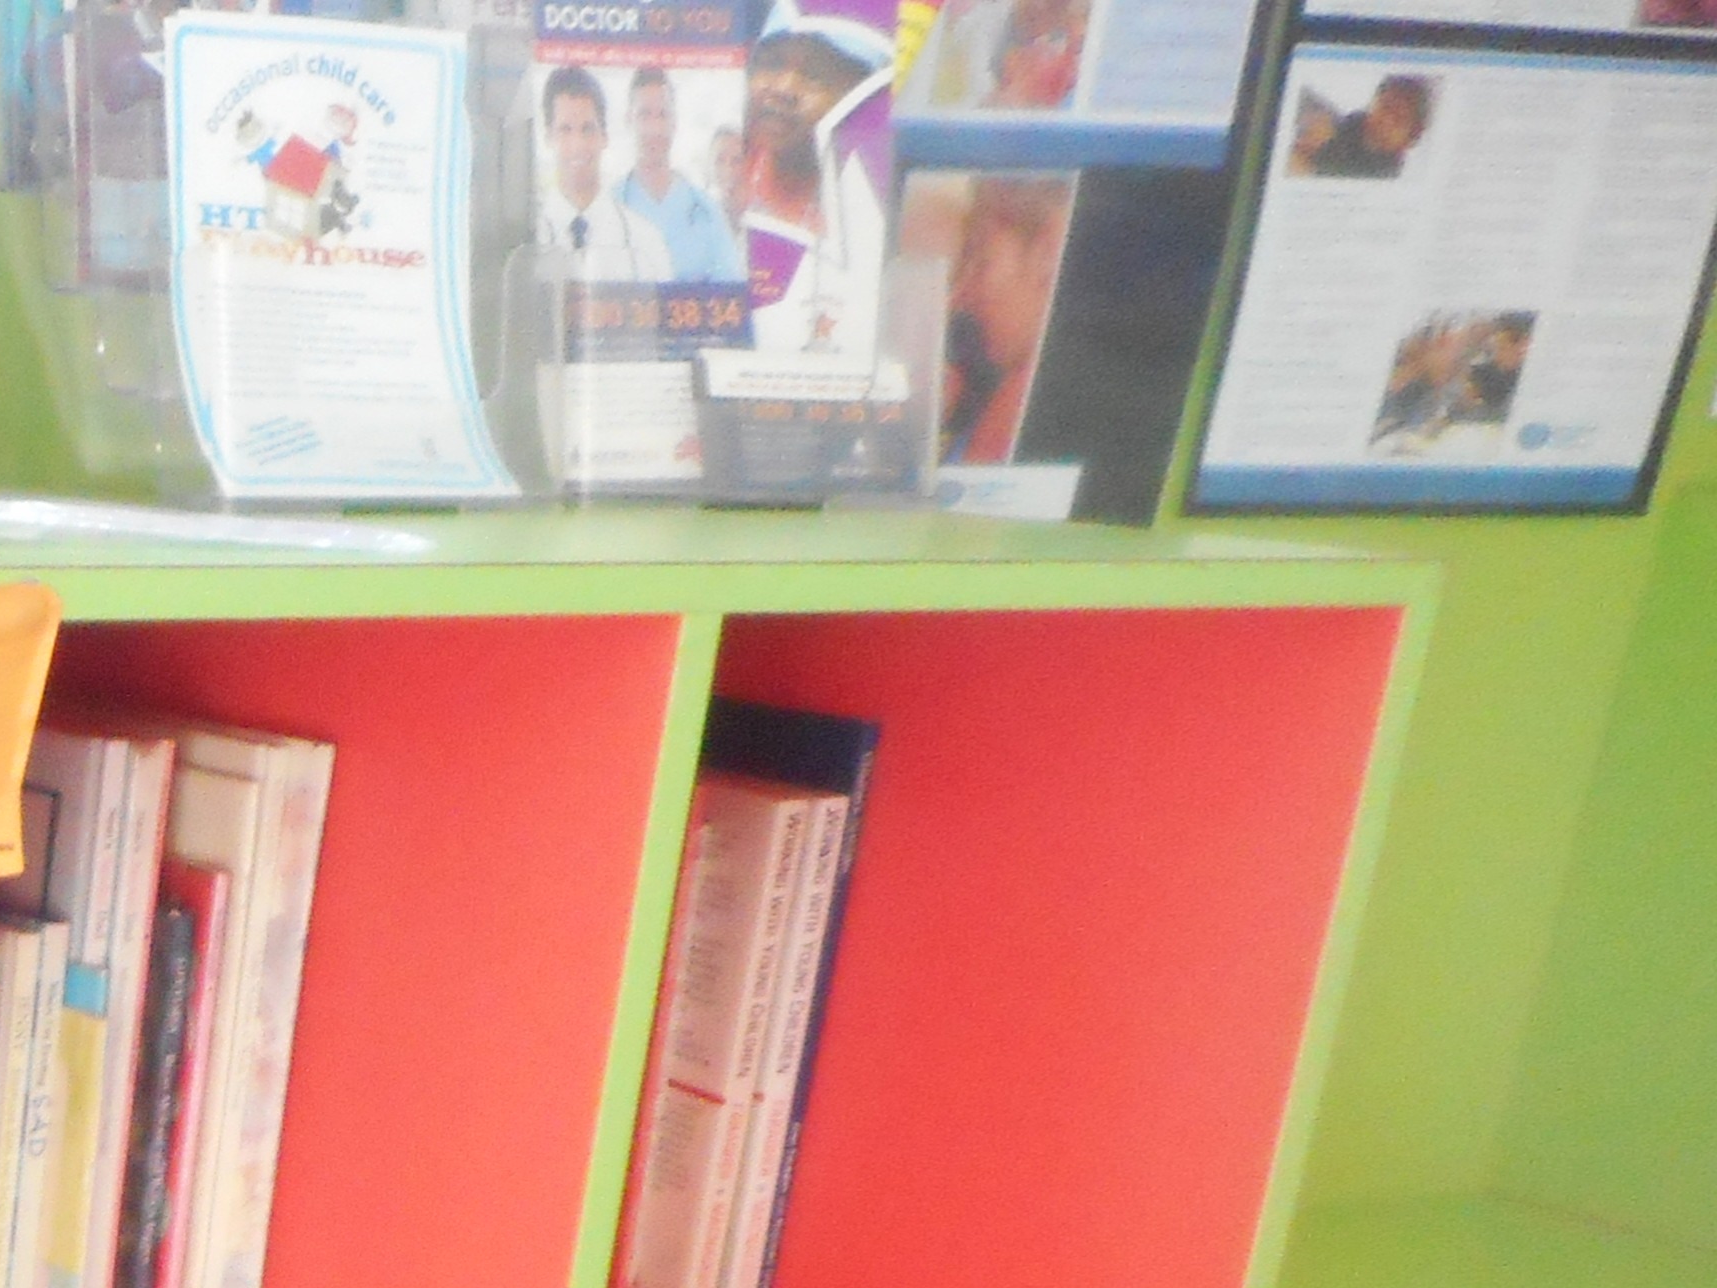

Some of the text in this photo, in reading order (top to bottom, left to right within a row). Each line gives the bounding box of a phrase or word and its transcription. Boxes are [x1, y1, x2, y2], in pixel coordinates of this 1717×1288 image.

[544, 6, 639, 31] DOCTOR
[306, 54, 358, 86] child
[359, 80, 397, 126] care
[199, 203, 265, 230] HT
[26, 1094, 52, 1158] SAD
